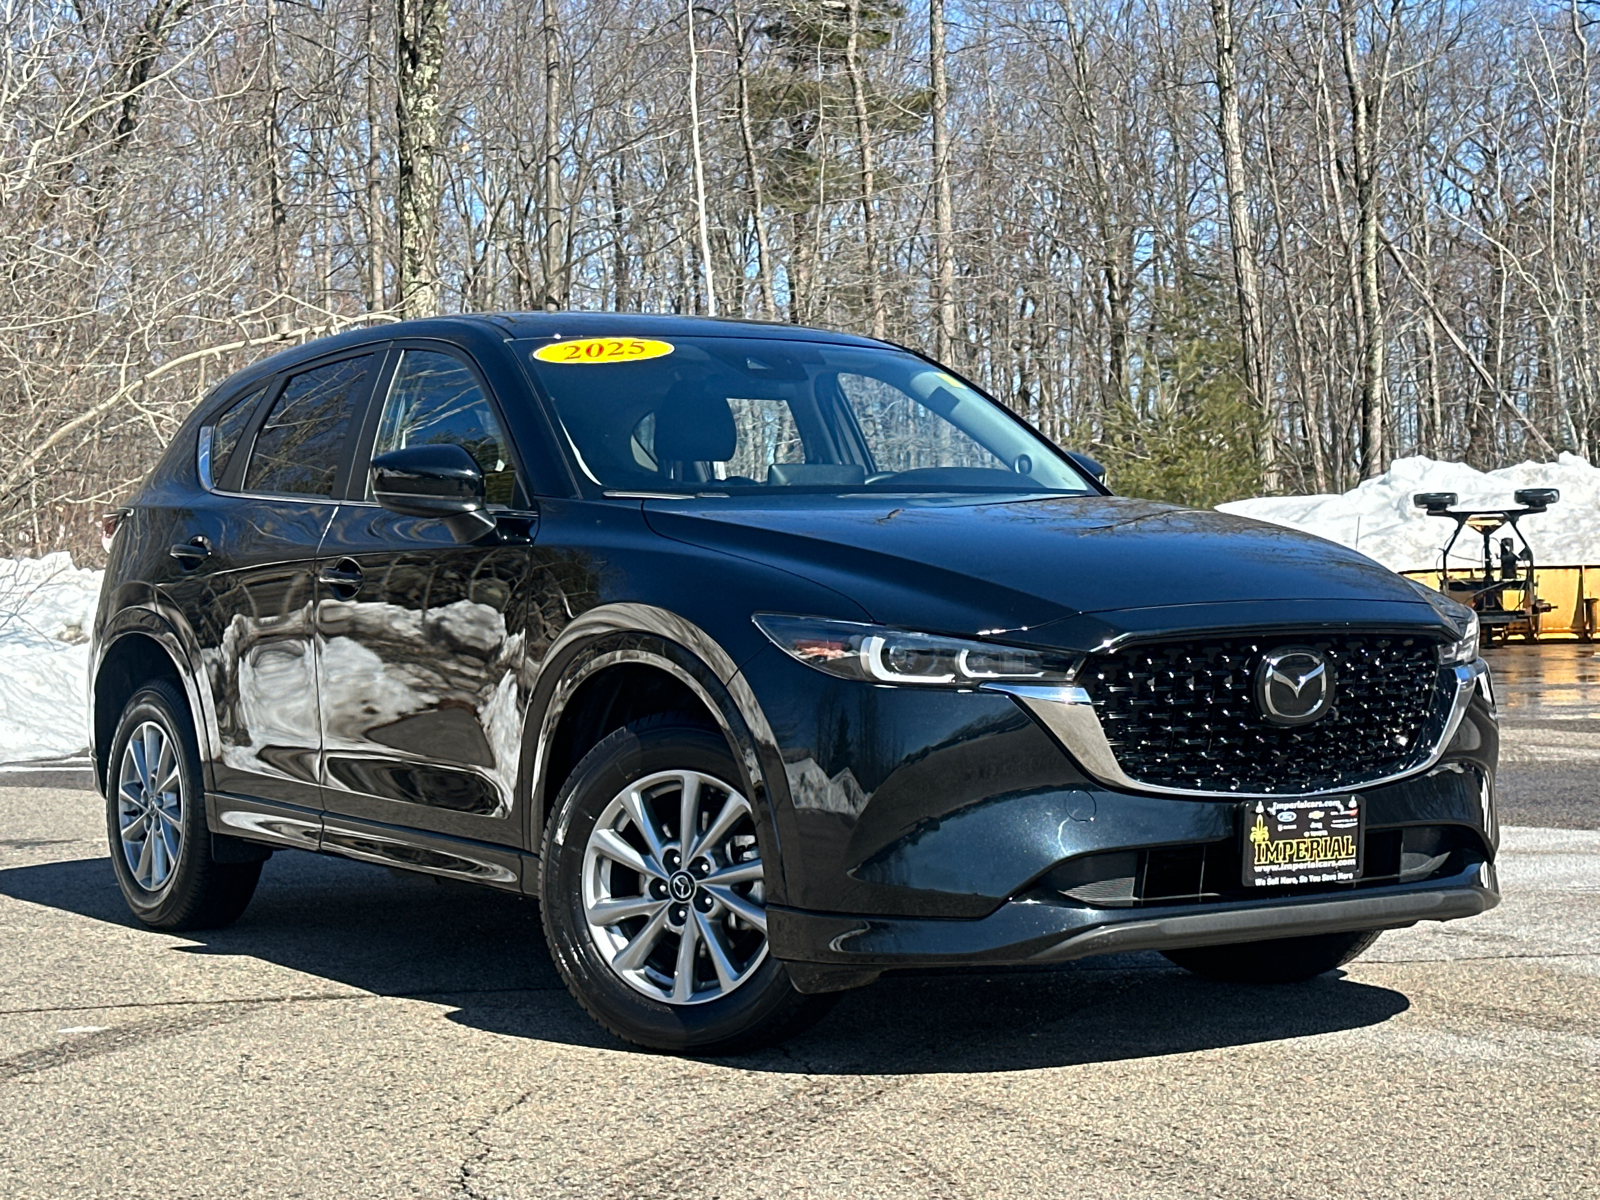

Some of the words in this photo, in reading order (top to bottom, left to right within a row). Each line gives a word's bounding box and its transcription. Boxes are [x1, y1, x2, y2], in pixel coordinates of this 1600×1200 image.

[563, 341, 646, 360] 2025
[1254, 835, 1356, 865] IMPERIAL
[1253, 859, 1356, 874] www.imperialcars.com
